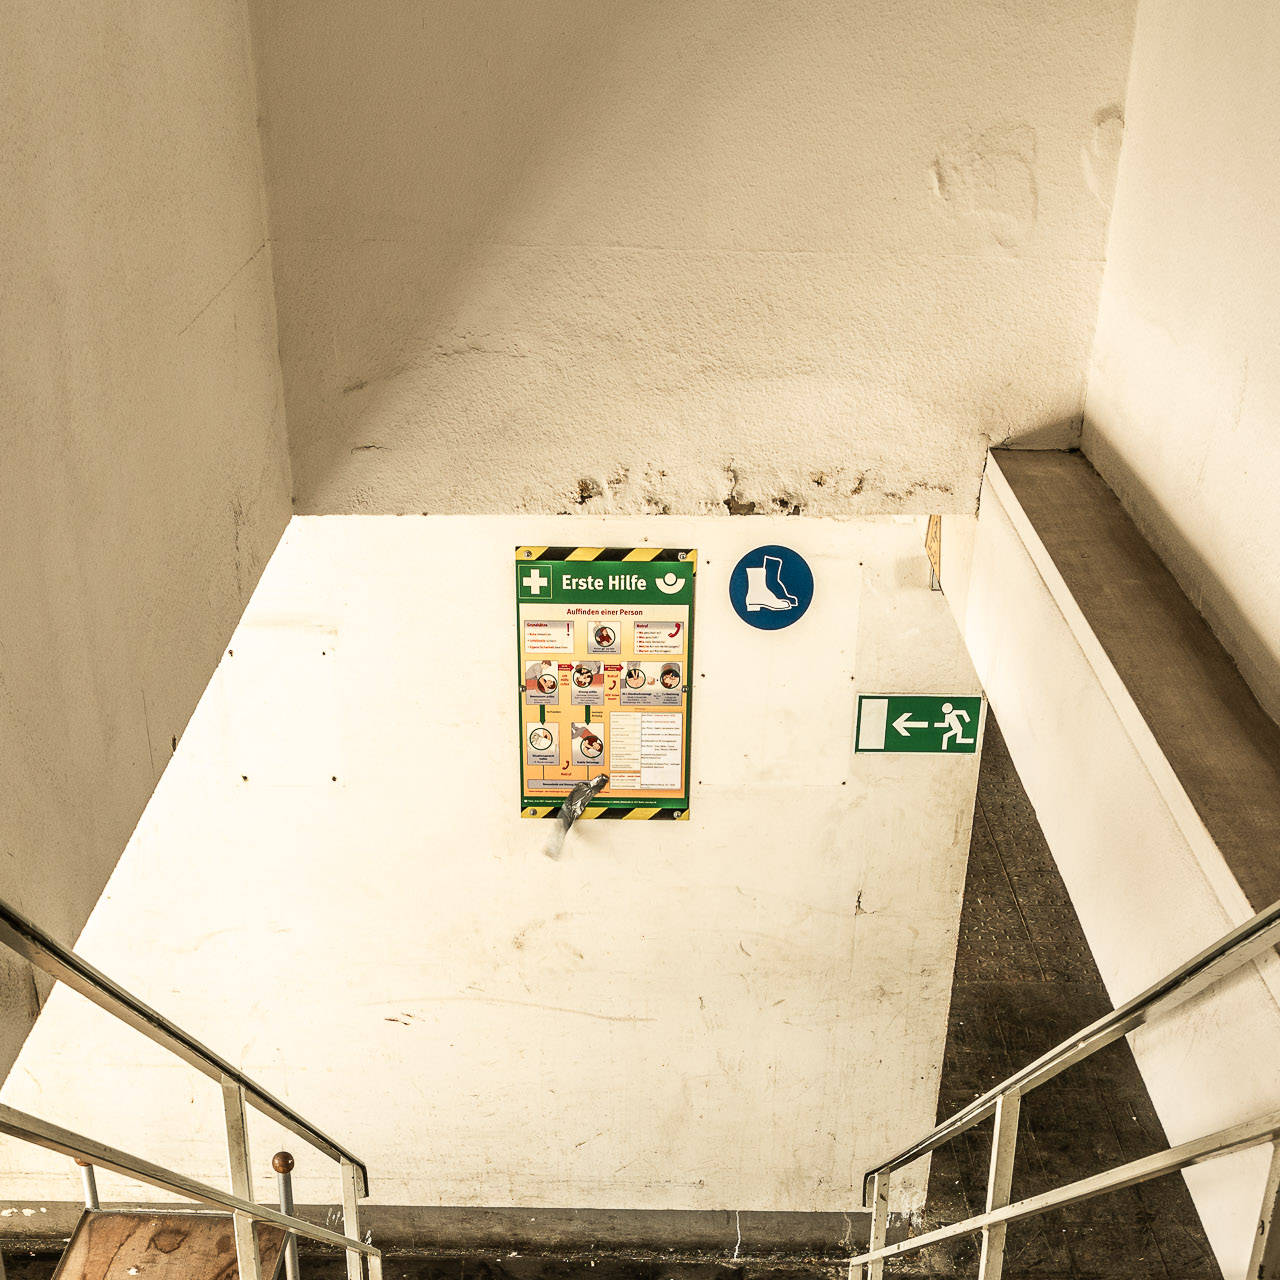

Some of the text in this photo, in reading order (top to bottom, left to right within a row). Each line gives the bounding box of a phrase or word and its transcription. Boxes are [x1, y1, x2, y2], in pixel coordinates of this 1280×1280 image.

[562, 574, 647, 591] Erste Hilfe
[566, 608, 643, 616] Auffinden einer Person
